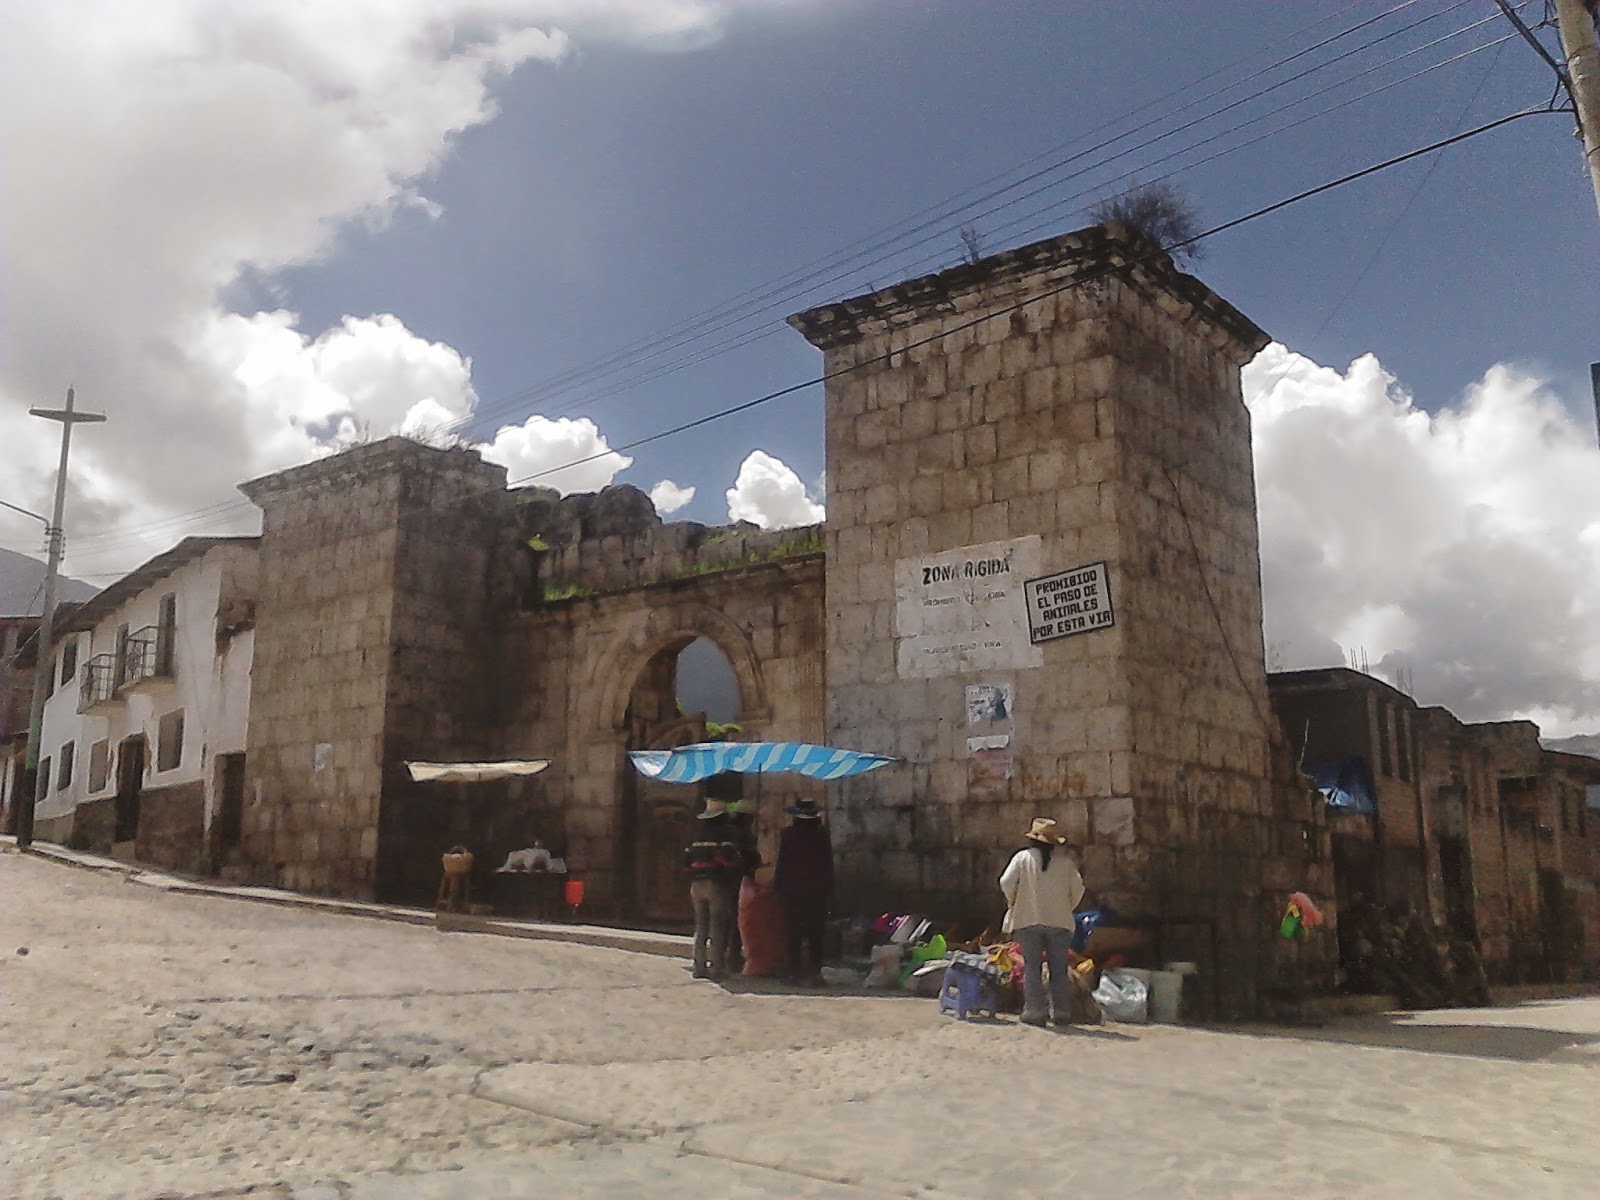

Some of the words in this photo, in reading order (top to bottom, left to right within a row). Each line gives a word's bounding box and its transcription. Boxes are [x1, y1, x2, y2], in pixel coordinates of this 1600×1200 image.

[1035, 570, 1097, 595] PROHIBIDO
[1037, 596, 1051, 609] EL
[1053, 588, 1081, 605] PASO
[1083, 583, 1099, 597] DE
[1043, 597, 1099, 621] ANIMALES
[1033, 624, 1053, 639] POR
[1057, 616, 1085, 633] ESTA
[1088, 610, 1110, 625] VIA
